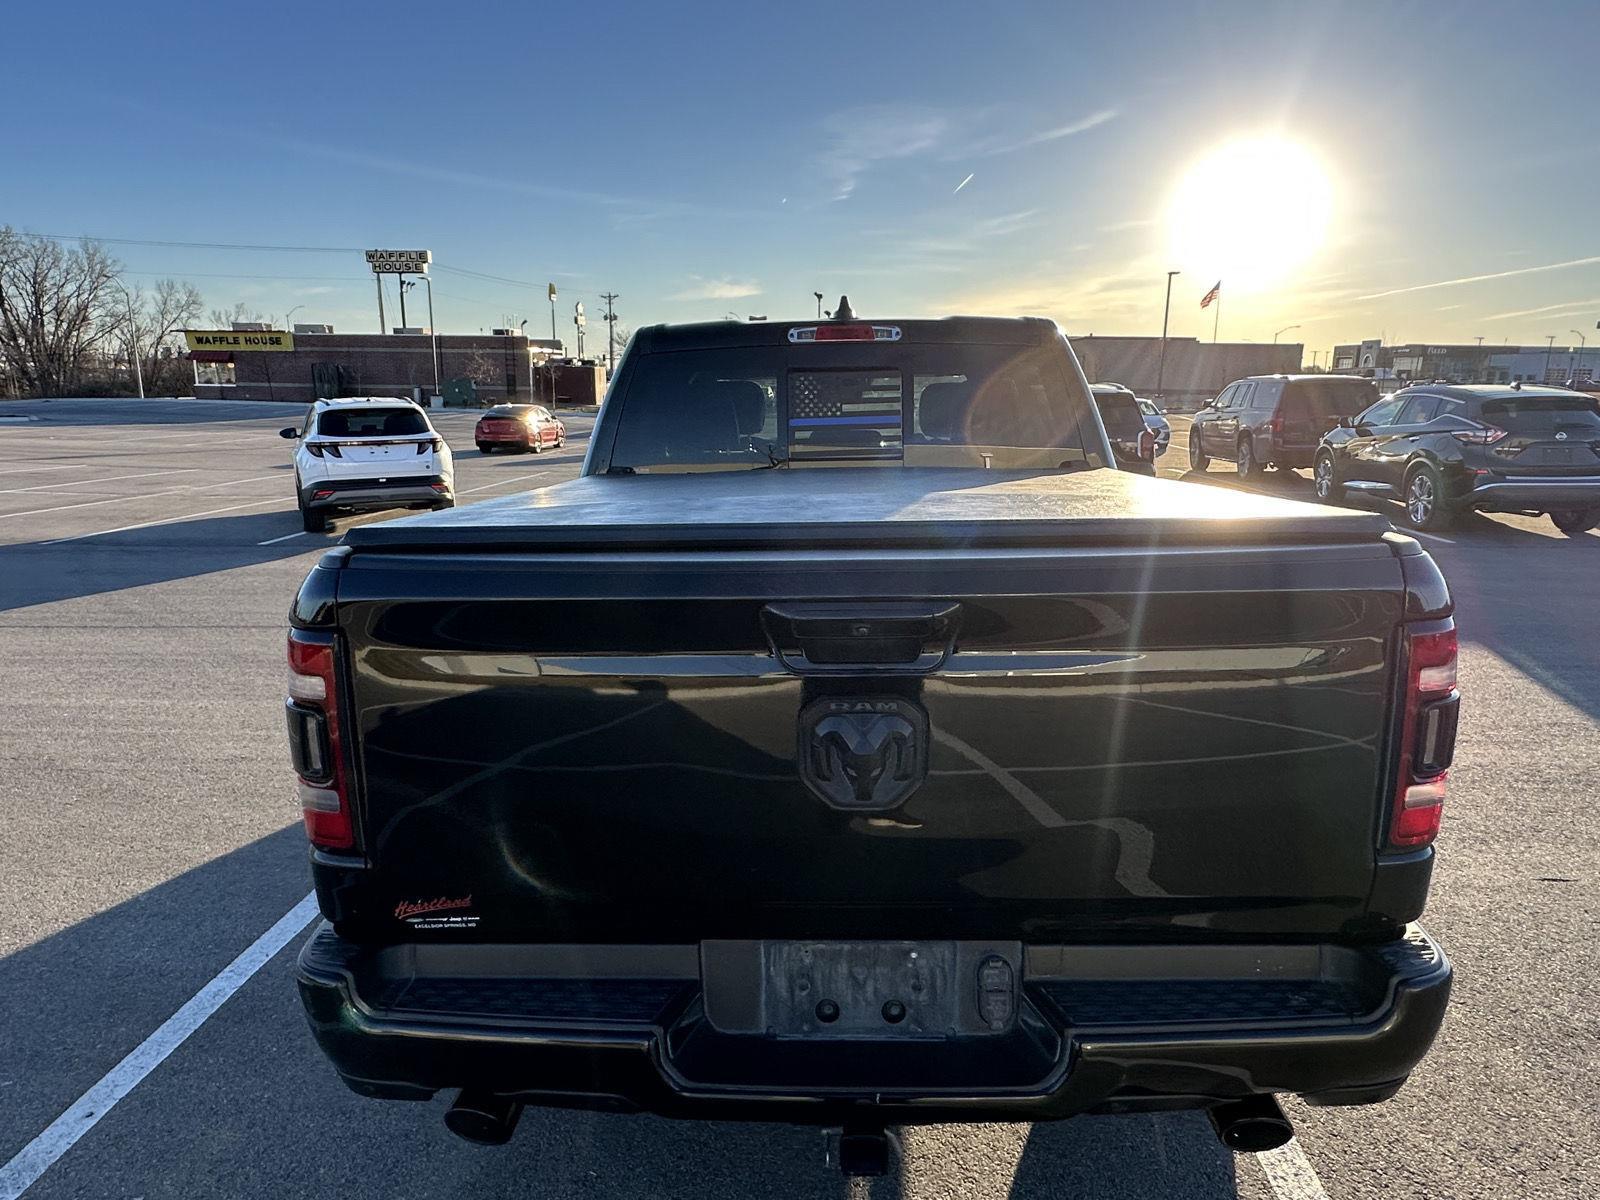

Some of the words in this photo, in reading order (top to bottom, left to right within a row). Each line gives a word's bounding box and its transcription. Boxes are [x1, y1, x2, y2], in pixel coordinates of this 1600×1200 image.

[367, 252, 427, 260] WAFFLE
[373, 262, 422, 271] HOUSE
[195, 336, 240, 345] WAFFLE
[244, 336, 283, 345] HOUSE
[829, 702, 898, 712] RAM
